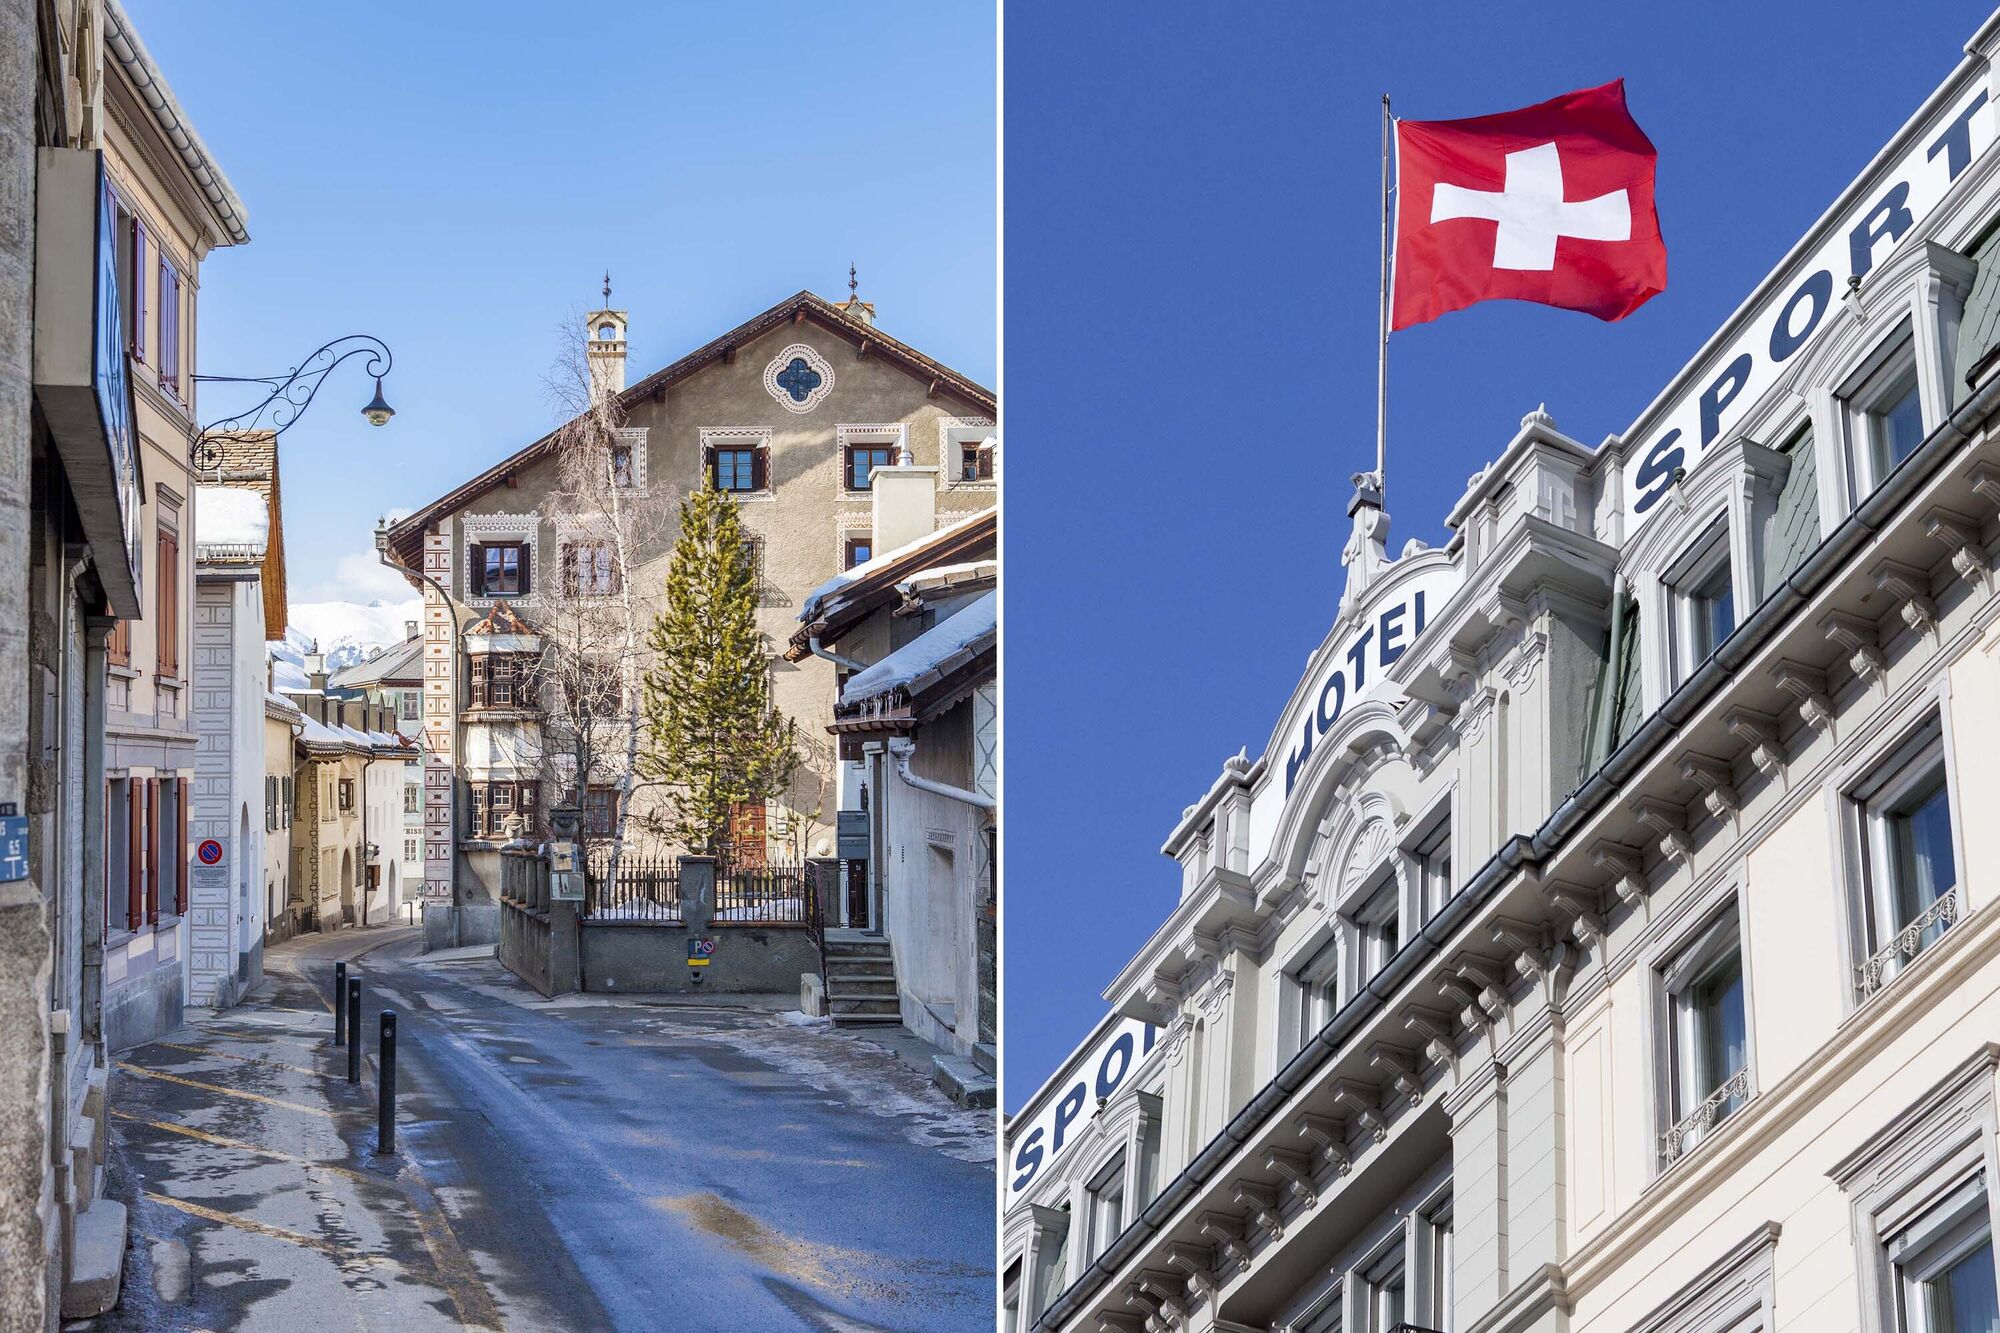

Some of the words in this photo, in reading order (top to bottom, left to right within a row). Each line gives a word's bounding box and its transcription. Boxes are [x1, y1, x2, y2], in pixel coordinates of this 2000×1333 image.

[1634, 87, 1989, 514] SPORT
[694, 940, 702, 953] P
[1013, 1023, 1155, 1192] SPO
